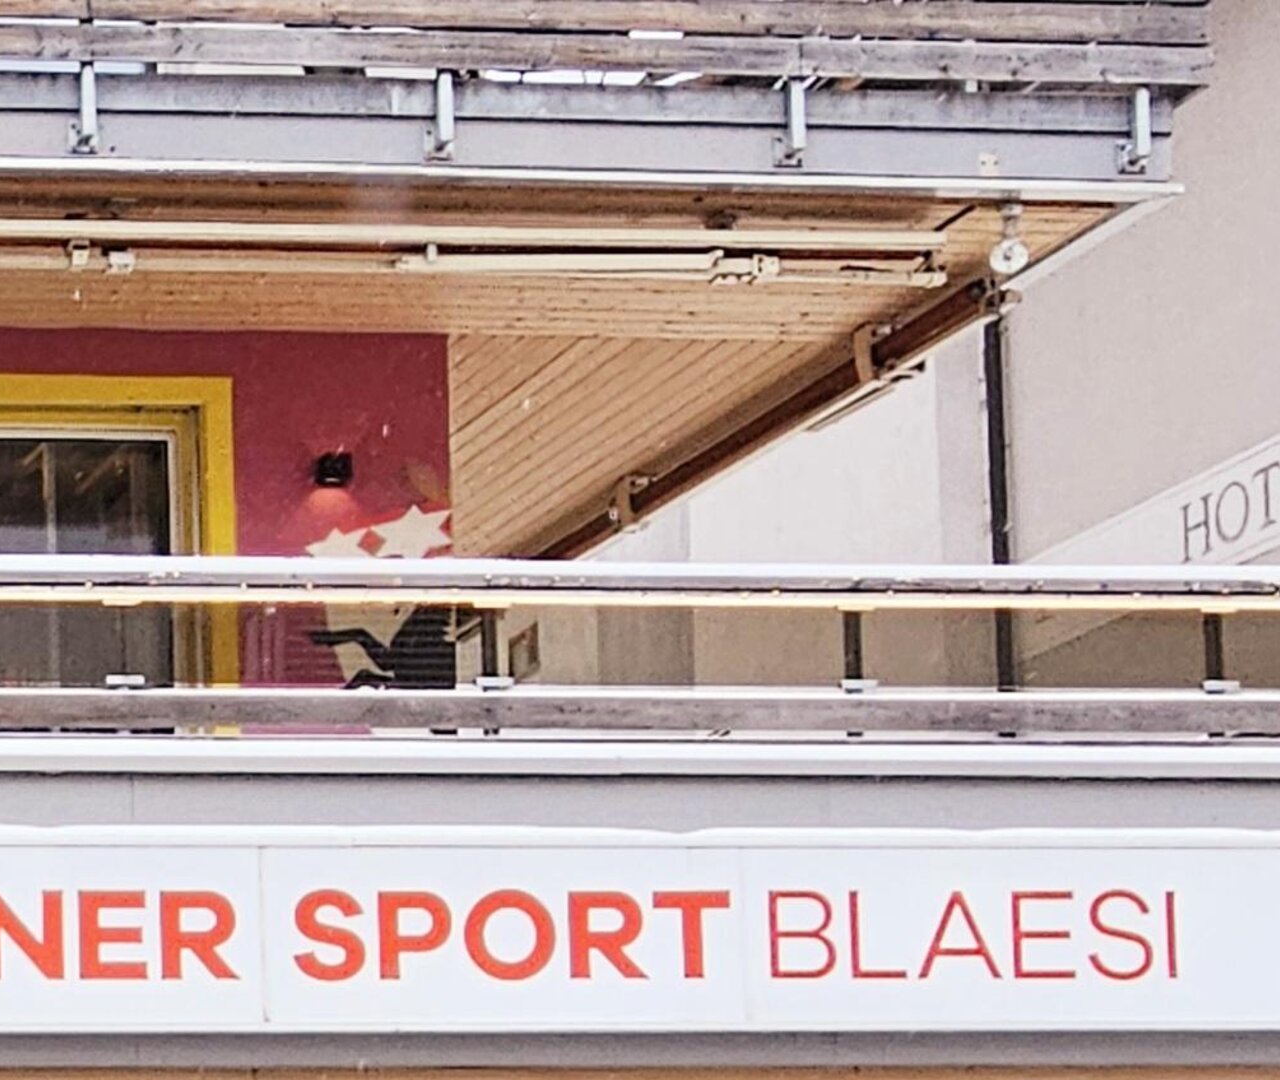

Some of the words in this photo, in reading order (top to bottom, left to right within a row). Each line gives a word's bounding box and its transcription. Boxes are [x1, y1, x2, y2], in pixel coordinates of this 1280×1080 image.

[1179, 460, 1280, 564] HOT
[295, 890, 731, 982] SPORT
[770, 891, 1176, 980] BLAESI
